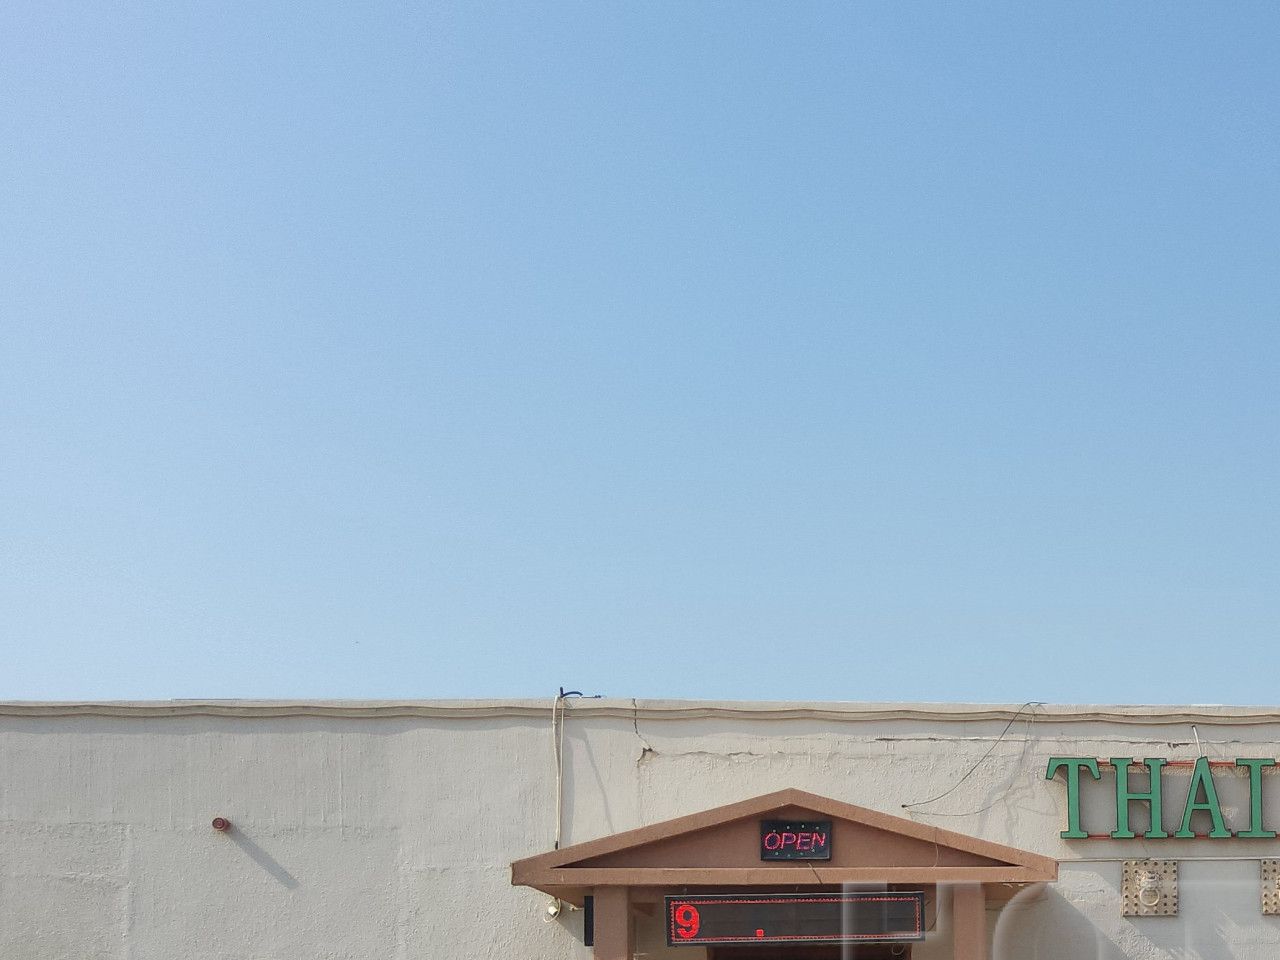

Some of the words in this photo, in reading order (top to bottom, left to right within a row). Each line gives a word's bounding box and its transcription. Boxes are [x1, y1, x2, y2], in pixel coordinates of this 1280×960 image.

[1046, 756, 1279, 839] THAI
[764, 832, 826, 850] OPEN
[675, 904, 700, 938] 9
